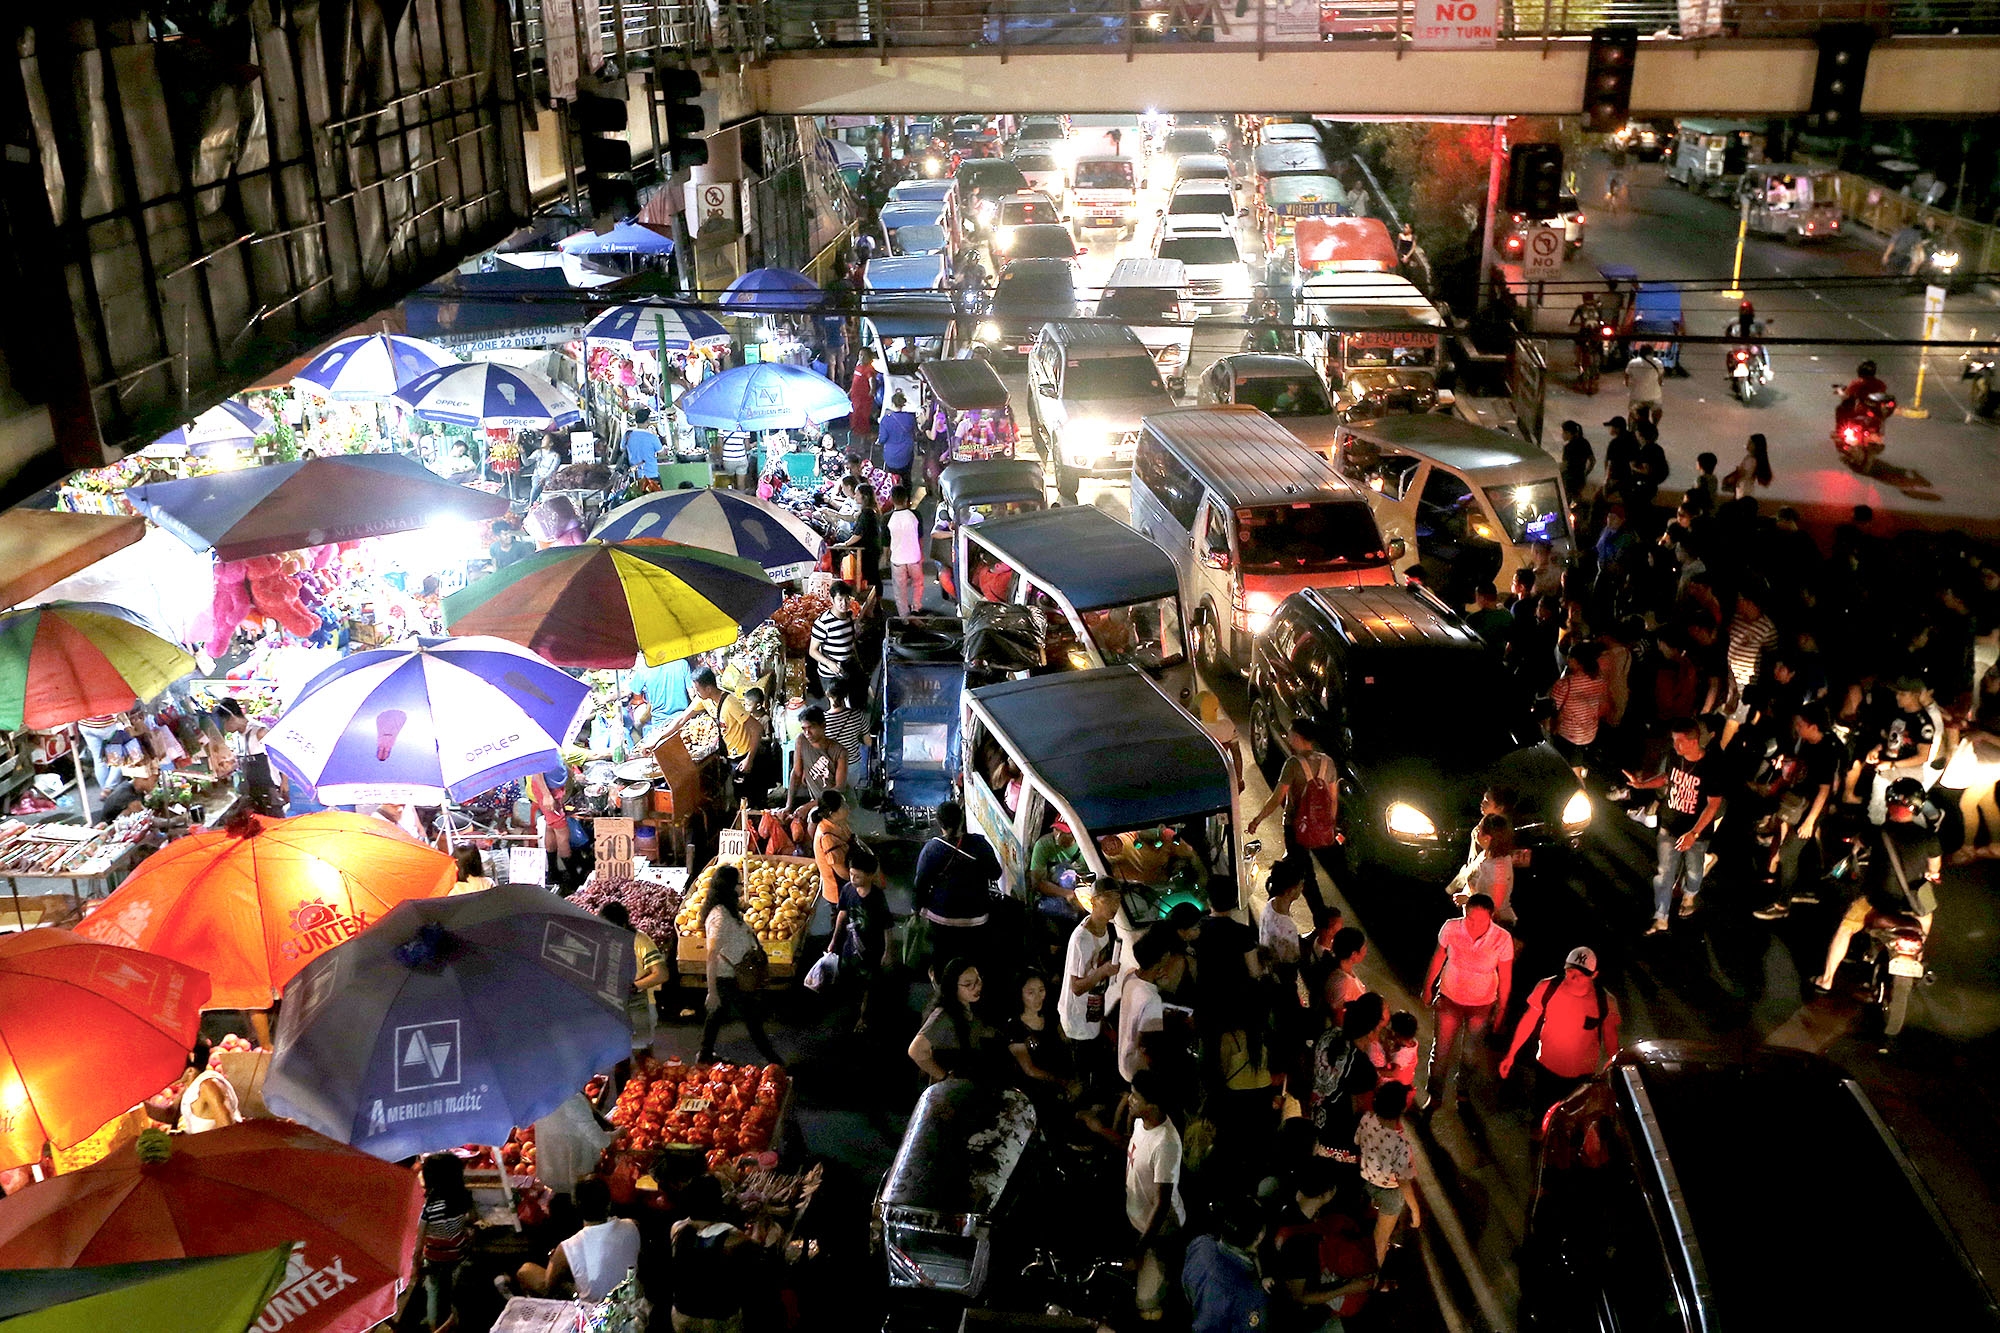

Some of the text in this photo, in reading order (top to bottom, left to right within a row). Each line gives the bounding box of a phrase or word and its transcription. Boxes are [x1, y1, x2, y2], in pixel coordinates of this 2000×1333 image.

[1436, 3, 1477, 21] NO
[1417, 26, 1492, 39] LEFT TURN
[1533, 258, 1553, 267] NO
[519, 326, 567, 338] COUNCIL
[471, 340, 497, 351] ZONE
[500, 339, 512, 349] 22
[515, 336, 539, 347] DIST.
[541, 336, 547, 344] 2
[435, 399, 463, 407] OPPLE
[502, 418, 528, 428] OPPLE
[768, 568, 791, 580] PPLE
[465, 738, 511, 763] OPPLE
[1667, 786, 1698, 815] SKATE
[720, 840, 743, 856] 100
[281, 911, 371, 961] SUNTEX
[367, 1087, 483, 1137] AMERICAN matic
